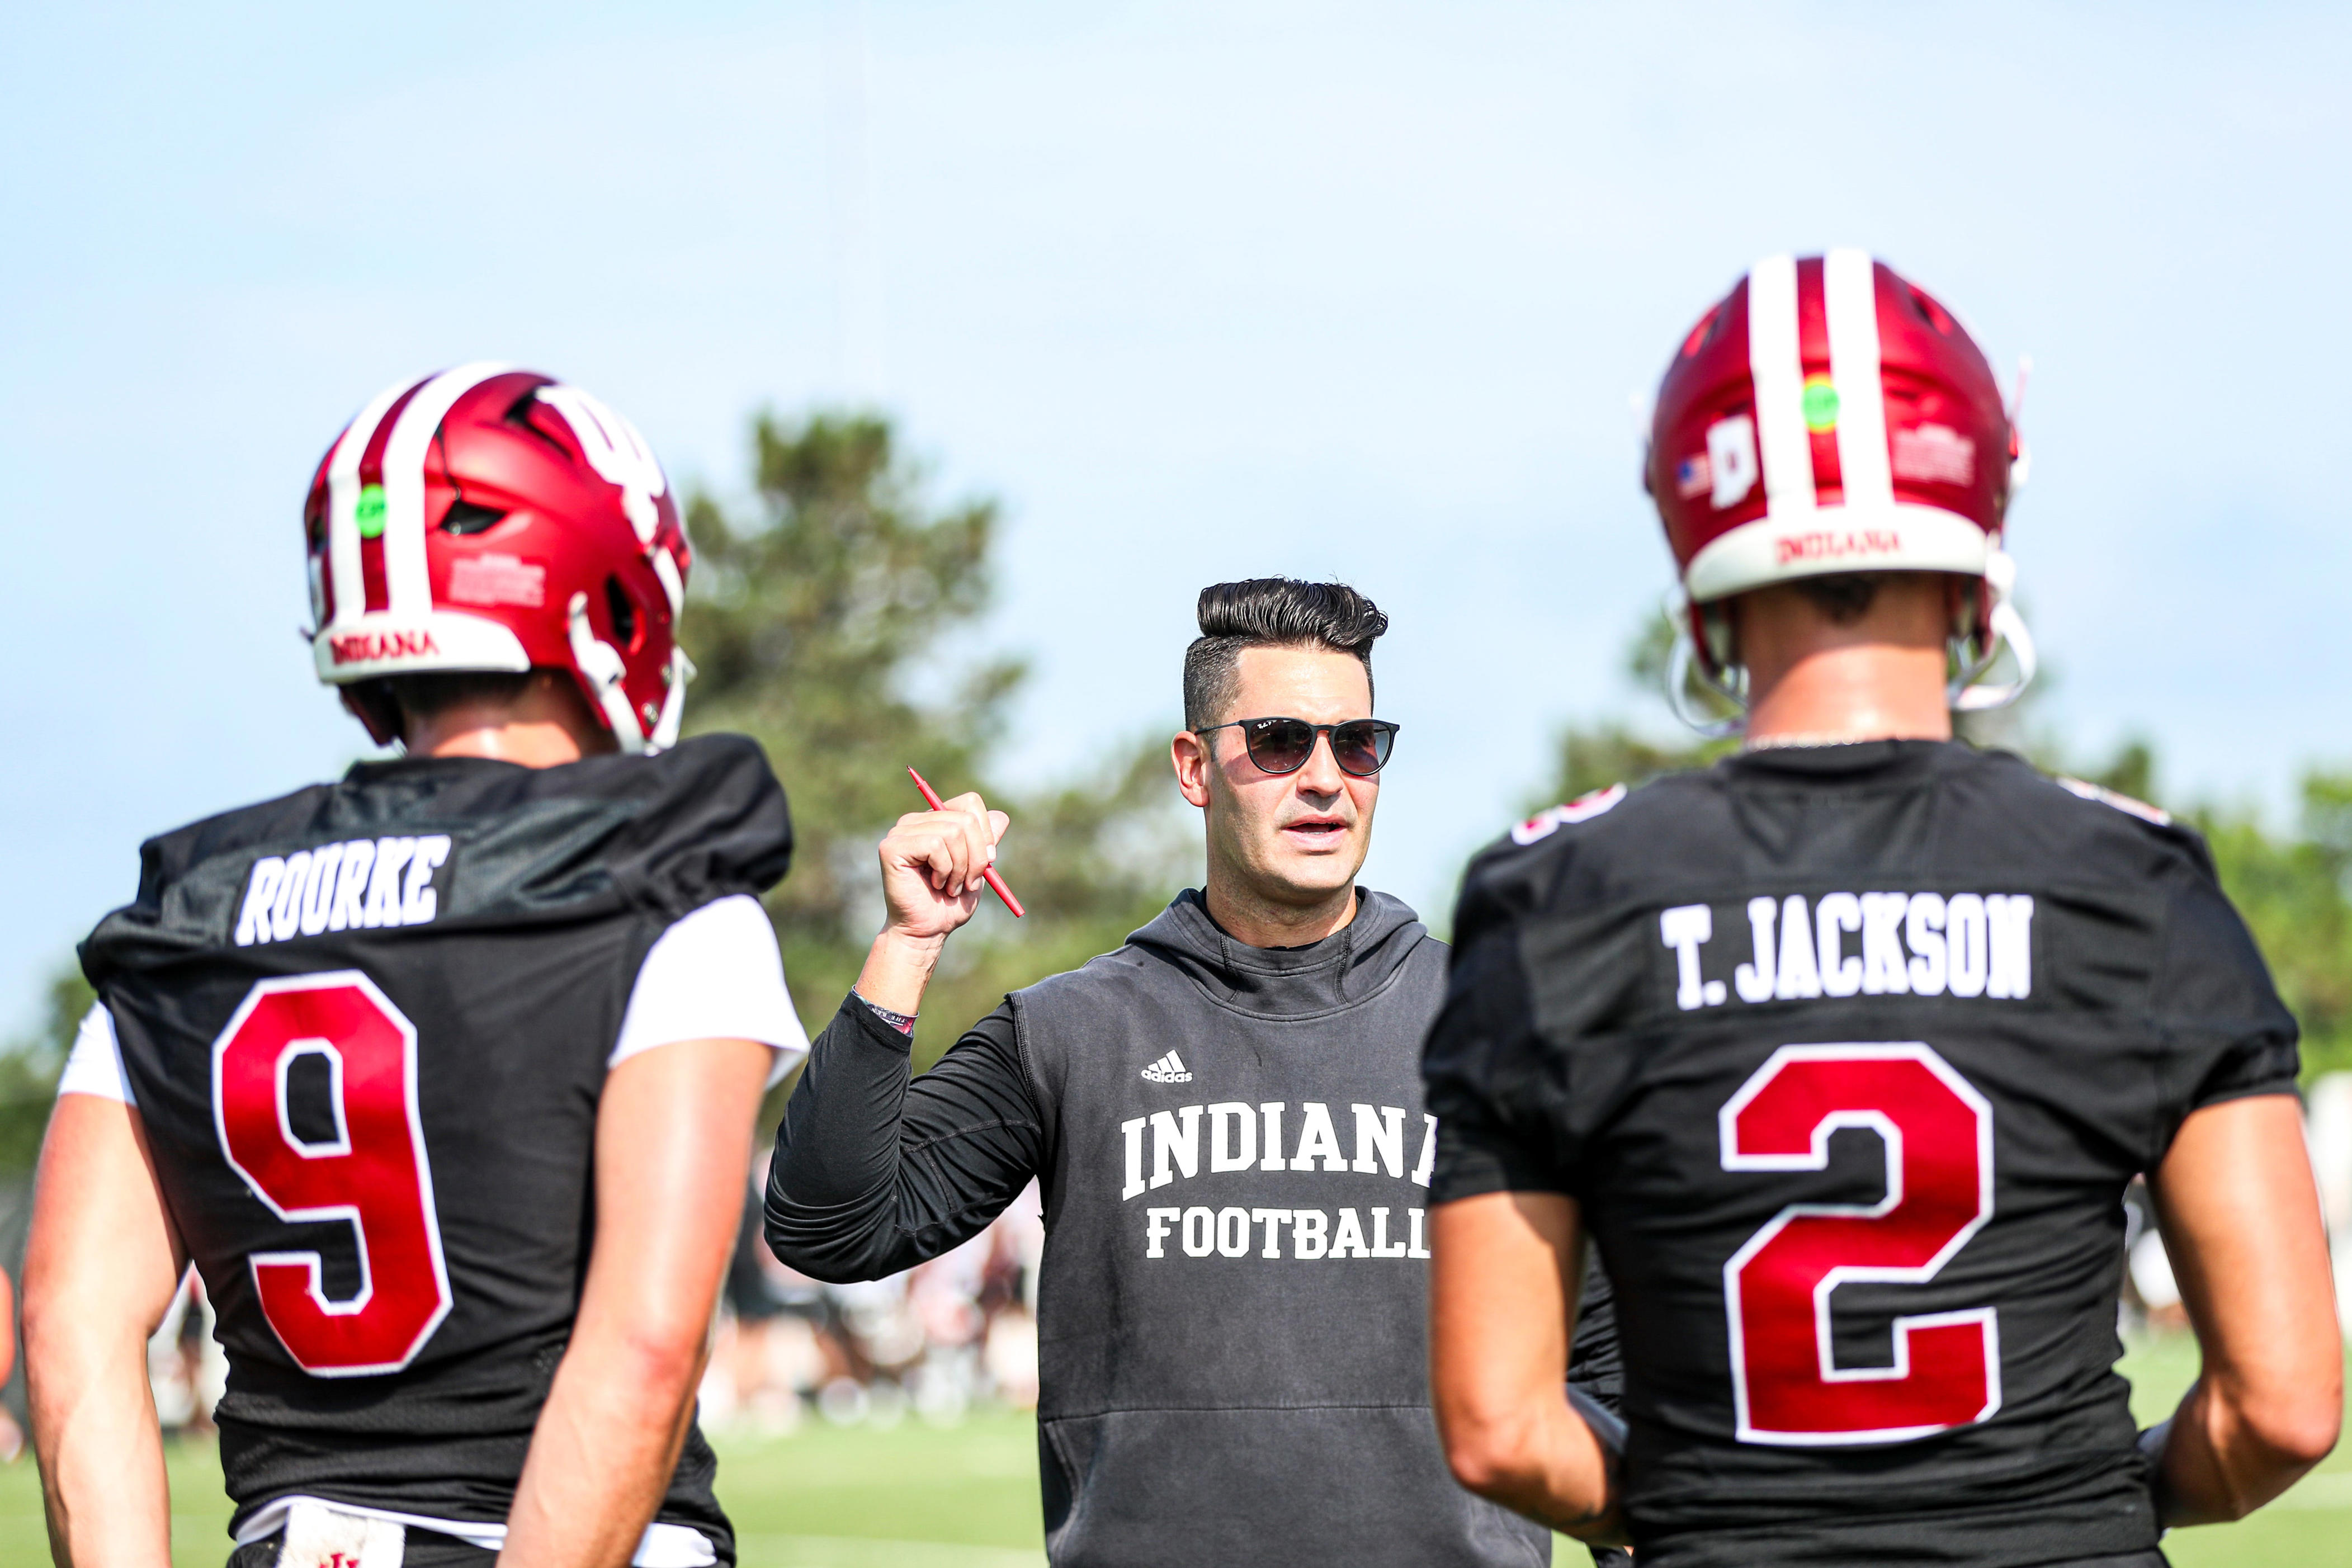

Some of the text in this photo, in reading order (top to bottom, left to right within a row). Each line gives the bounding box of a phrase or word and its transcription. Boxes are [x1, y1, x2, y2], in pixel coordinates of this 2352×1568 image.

[235, 835, 451, 946] ROURKE
[1660, 892, 2034, 1010] T. JACKSON
[1141, 1069, 1193, 1083] adidas
[211, 969, 454, 1378] 9
[1146, 1206, 1431, 1260] FOOTBALL
[1718, 1041, 2002, 1446] 2
